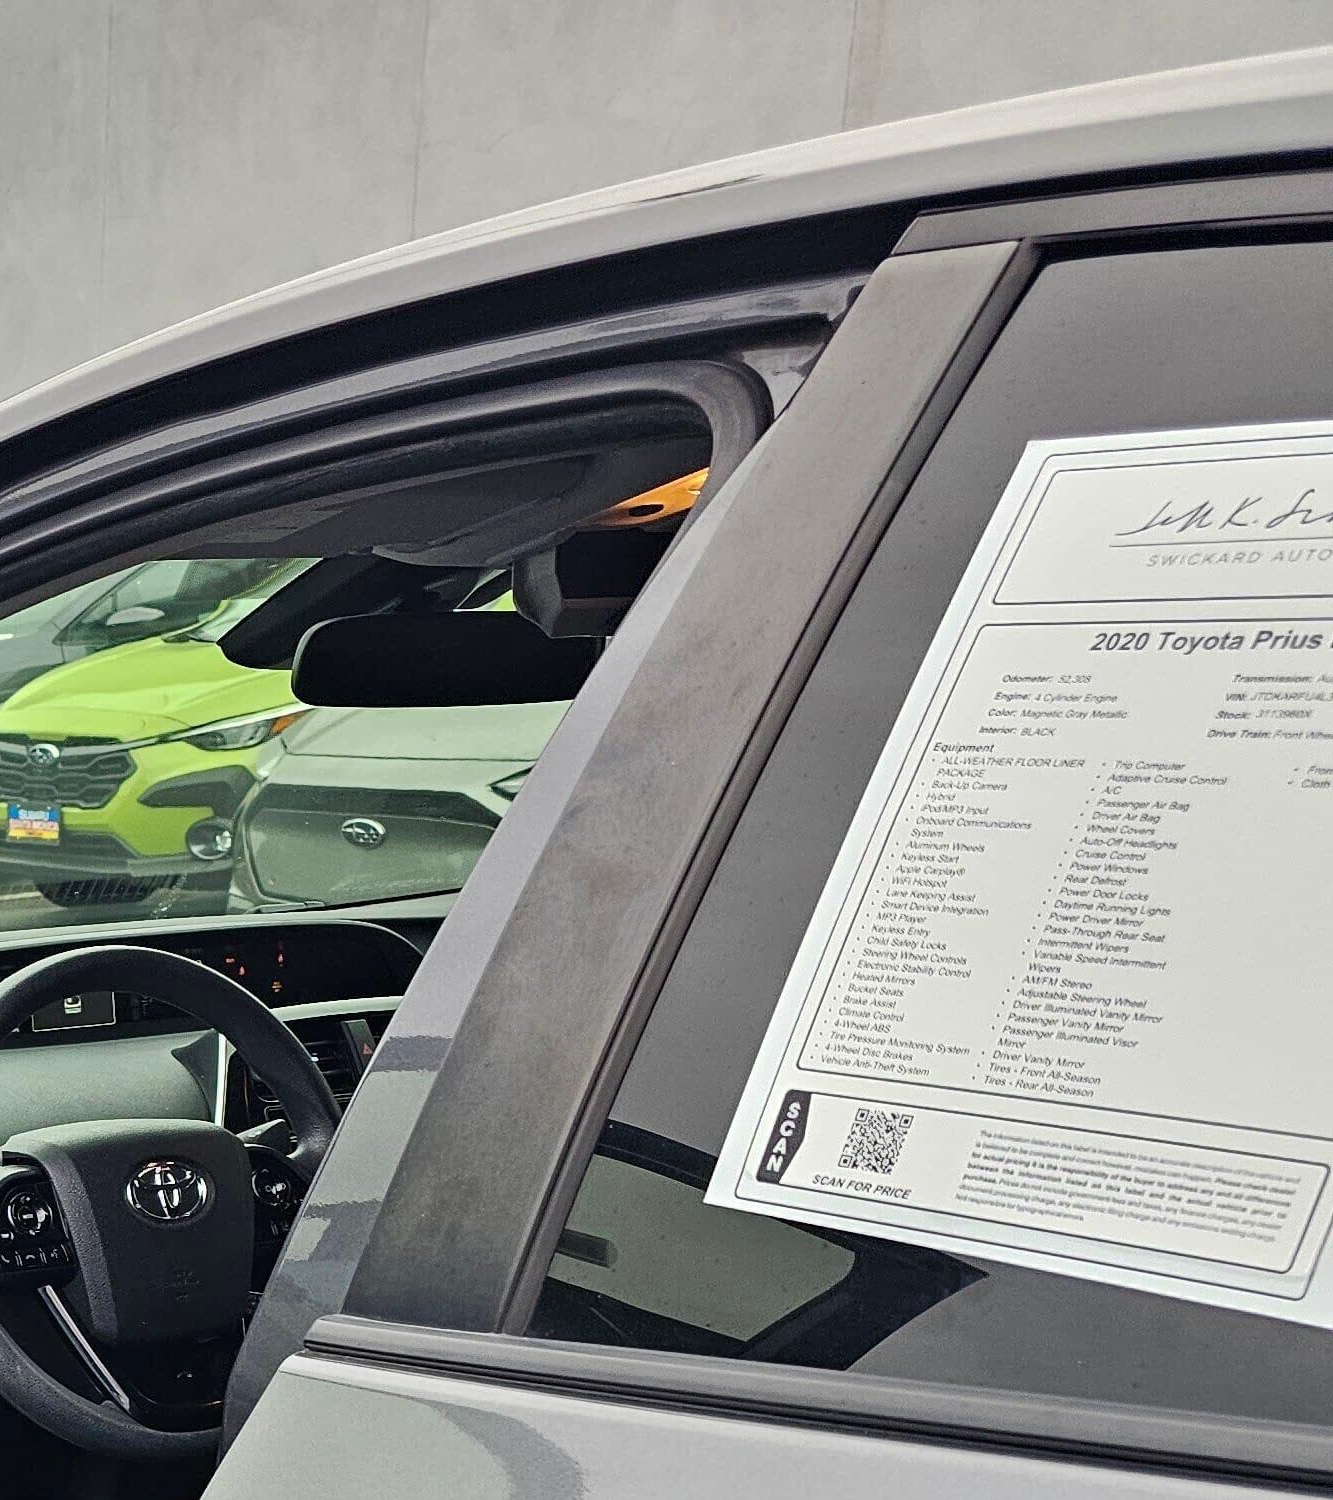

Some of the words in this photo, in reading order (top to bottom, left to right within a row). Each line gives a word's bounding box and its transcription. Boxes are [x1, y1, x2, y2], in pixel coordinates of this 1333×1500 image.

[1146, 551, 1262, 568] SWICKARD
[1089, 632, 1150, 651] 2020
[1157, 631, 1245, 655] Toyota
[1251, 630, 1323, 650] Prius
[1002, 674, 1053, 683] Odometer:
[1233, 674, 1312, 683] Transmission:
[994, 692, 1030, 702] Engine:
[1043, 693, 1082, 703] Cylinder
[1084, 694, 1118, 704] Engine
[988, 708, 1016, 717] Color:
[1020, 709, 1062, 719] Magnetic
[1065, 710, 1088, 720] Gray
[1090, 710, 1127, 719] Metallic
[1215, 710, 1251, 719] Stock:
[979, 726, 1017, 735] Interior:
[1020, 727, 1057, 736] BLACK
[1207, 729, 1236, 738] Drive
[1240, 729, 1271, 739] Train:
[1274, 730, 1303, 739] Front
[933, 742, 995, 754] Equipment
[940, 756, 1013, 766] ALL-WEATHER
[1013, 757, 1051, 768] FLOOR
[1052, 758, 1085, 767] LINER
[1114, 759, 1133, 769] Trip
[1135, 760, 1186, 771] Computer
[935, 767, 985, 777] PACKAGE
[1106, 773, 1151, 784] Adaptive
[1153, 773, 1187, 784] Cruise
[1188, 774, 1227, 785] Control
[931, 779, 969, 790] Back-Up
[971, 780, 1007, 791] Camera
[1302, 779, 1331, 789] Cloth
[965, 805, 989, 815] Input
[1096, 798, 1150, 810] Passenger
[1150, 800, 1167, 809] Air
[1168, 800, 1190, 812] Bag
[956, 817, 1032, 829] Communications
[1091, 810, 1121, 820] Driver
[1121, 812, 1138, 821] Air
[1138, 812, 1161, 824] Bag
[910, 828, 943, 839] System
[1086, 824, 1118, 833] Wheel
[1119, 824, 1155, 835] Covers
[952, 841, 985, 852] Wheels
[1078, 836, 1123, 846] Auto-Off
[1123, 839, 1178, 851] Headlights
[900, 851, 935, 862] Keyless
[936, 853, 959, 864] Start
[1075, 848, 1107, 859] Cruise
[1109, 850, 1147, 861] Control
[894, 863, 921, 874] Apple
[1069, 861, 1101, 871] Power
[1103, 862, 1149, 874] Windows
[912, 877, 947, 888] Hotspot
[1063, 873, 1089, 883] Rear
[1089, 875, 1129, 887] Defrost
[885, 887, 908, 897] Lane
[909, 889, 947, 903] Keeping
[946, 892, 976, 902] Assist
[1058, 886, 1090, 896] Power
[1092, 889, 1117, 898] Door
[1118, 890, 1149, 901] Locks
[880, 899, 908, 910] Smart
[908, 901, 939, 912] Device
[940, 903, 989, 916] Integration
[1053, 899, 1093, 910] Daytime
[1095, 902, 1138, 916] Running
[1139, 905, 1171, 917] Lights
[875, 911, 897, 921] MP3
[897, 913, 927, 925] Player
[1047, 911, 1080, 922] Power
[1081, 914, 1112, 925] Driver
[1113, 916, 1144, 927] Mirror
[870, 923, 905, 935] Keyless
[906, 926, 931, 938] Entry
[1042, 923, 1111, 940] Pass-Through
[1113, 929, 1139, 940] Rear
[1140, 931, 1166, 943] Seat
[866, 935, 889, 945] Child
[890, 937, 919, 950] Safety
[919, 939, 947, 951] Locks
[1037, 937, 1093, 950] Intermittent
[1094, 942, 1129, 953] Wipers
[861, 947, 897, 961] Steering
[899, 950, 928, 961] Wheel
[929, 952, 967, 965] Controls
[1074, 952, 1108, 964] Speed
[1108, 956, 1166, 970] Intermittent
[856, 958, 899, 972] Electronic
[900, 963, 936, 976] Stability
[938, 966, 971, 978] Control
[1028, 961, 1061, 974] Wipers
[851, 970, 884, 982] Heated
[884, 974, 915, 985] Mirrors
[1059, 977, 1093, 990] Stereo
[847, 982, 877, 994] Bucket
[878, 985, 904, 997] Seats
[842, 994, 868, 1005] Brake
[868, 997, 896, 1009] Assist
[1016, 987, 1067, 1000] Adjustable
[1069, 992, 1111, 1007] Steering
[1114, 997, 1147, 1008] Wheel
[838, 1006, 870, 1018] Climate
[872, 1010, 904, 1024] Control
[1012, 999, 1042, 1011] Driver
[1099, 1008, 1130, 1022] Vanity
[1131, 1012, 1164, 1023] Mirror
[869, 1022, 891, 1033] ABS
[1006, 1011, 1059, 1027] Passenger
[1061, 1017, 1092, 1031] Vanity
[1093, 1021, 1124, 1033] Mirror
[830, 1030, 846, 1040] Tire
[847, 1032, 886, 1045] Pressure
[887, 1037, 933, 1053] Monitoring
[935, 1042, 970, 1055] System
[996, 1037, 1026, 1048] Mirror
[1001, 1024, 1054, 1040] Passenger
[1112, 1036, 1139, 1048] Visor
[861, 1047, 881, 1057] Disc
[882, 1049, 913, 1061] Brakes
[992, 1049, 1021, 1061] Driver
[1024, 1052, 1053, 1067] Vanity
[1055, 1056, 1085, 1069] Mirror
[820, 1053, 851, 1066] Vehicle
[851, 1058, 895, 1072] Anti-Theft
[896, 1064, 929, 1076] System
[989, 1061, 1011, 1073] Tires
[1019, 1065, 1046, 1078] Front
[1046, 1069, 1101, 1085] All-Season
[984, 1074, 1006, 1086] Tires
[1014, 1078, 1039, 1090] Rear
[1039, 1082, 1094, 1097] All-Season
[766, 1101, 802, 1173] SCAN
[812, 1174, 846, 1190] SCAN
[846, 1180, 873, 1194] FOR
[873, 1184, 913, 1200] PRICE
